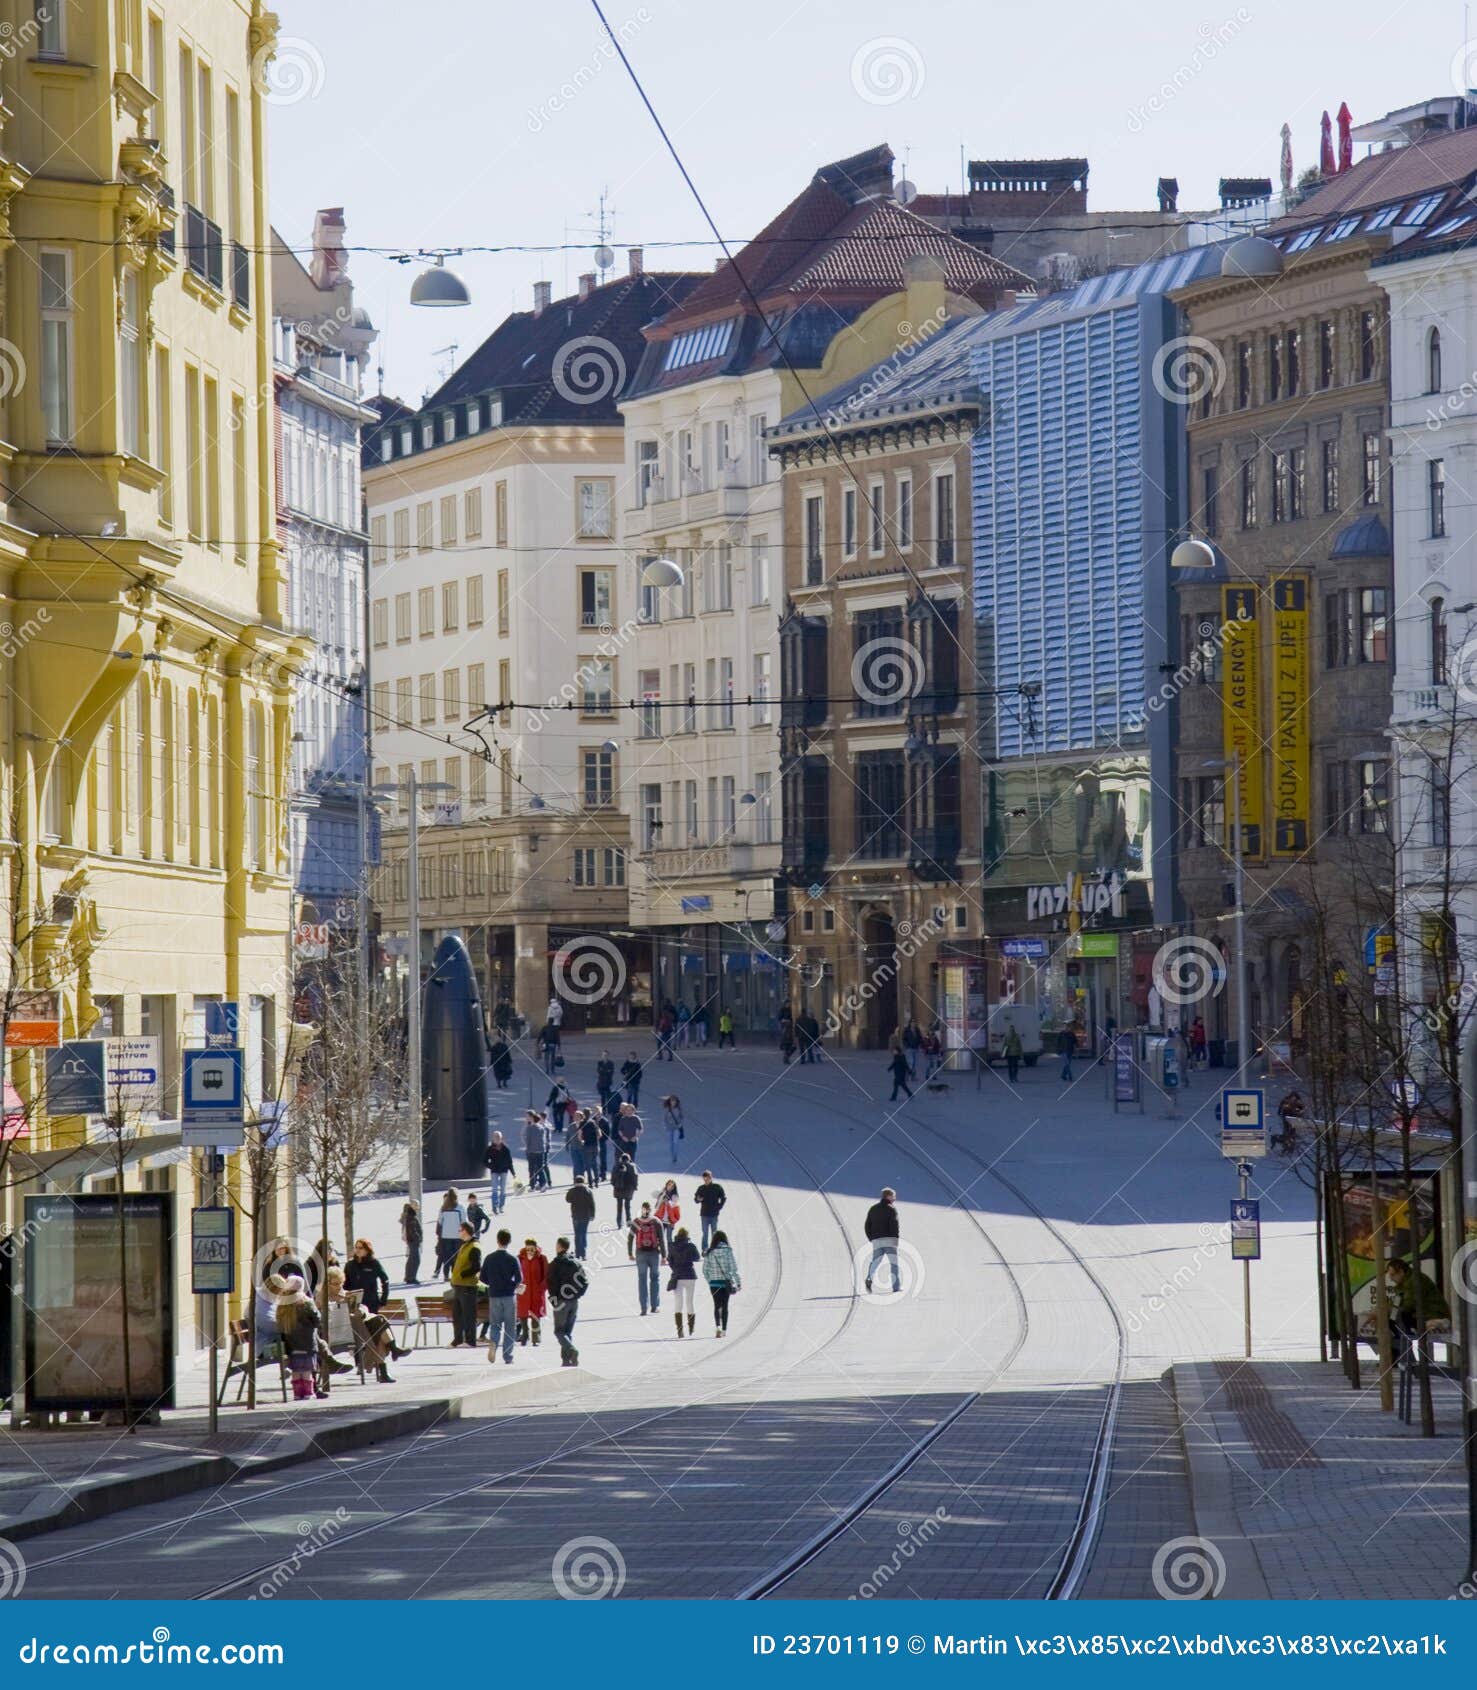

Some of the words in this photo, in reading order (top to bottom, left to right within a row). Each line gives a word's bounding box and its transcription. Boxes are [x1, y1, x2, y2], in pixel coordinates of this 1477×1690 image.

[1232, 637, 1246, 709] AGENCY
[1281, 670, 1296, 680] Z
[1277, 691, 1296, 748] PANŮ
[1278, 760, 1296, 811] DŮM
